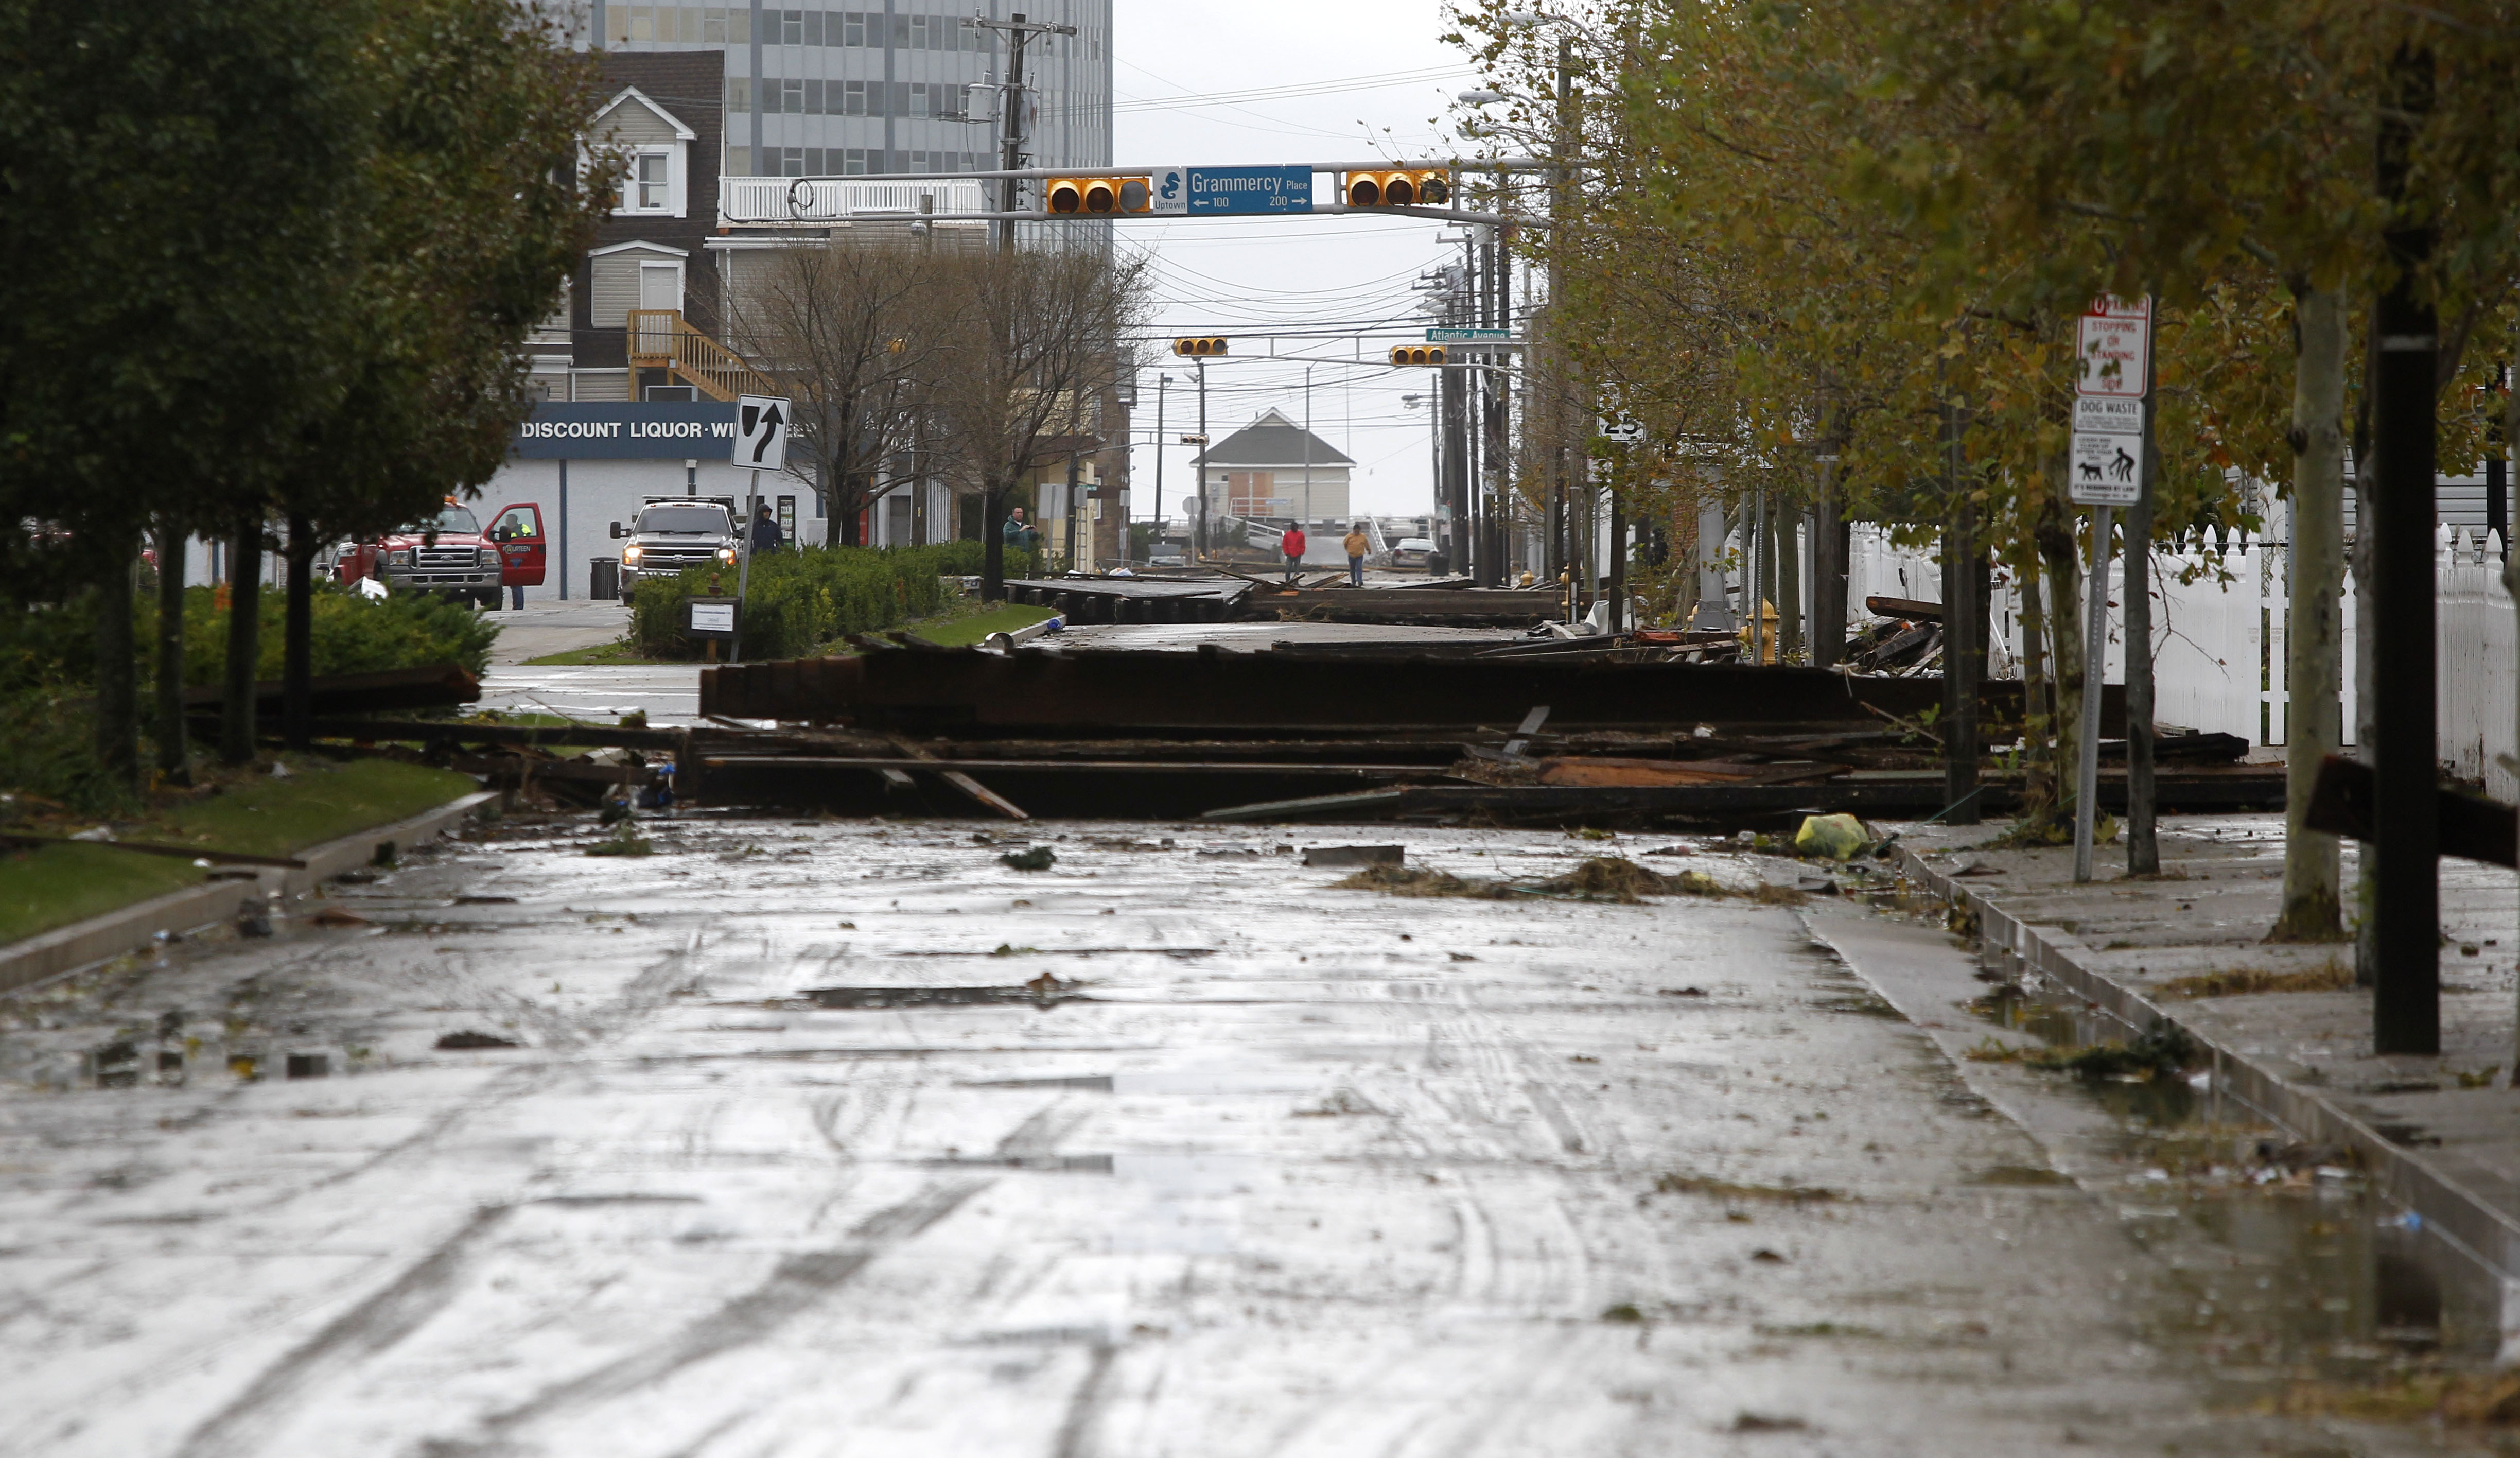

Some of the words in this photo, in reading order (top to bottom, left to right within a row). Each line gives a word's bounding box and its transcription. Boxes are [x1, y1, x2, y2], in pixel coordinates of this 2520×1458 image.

[1192, 172, 1282, 195] Grammercy
[1286, 180, 1307, 190] Place
[1154, 200, 1186, 211] Uptown
[1213, 196, 1229, 207] 100
[1269, 195, 1287, 206] 200
[1431, 329, 1468, 340] Atlantic
[2080, 401, 2103, 413] DOG
[2106, 402, 2137, 414] WASTE
[521, 422, 621, 438] DISCOUNT
